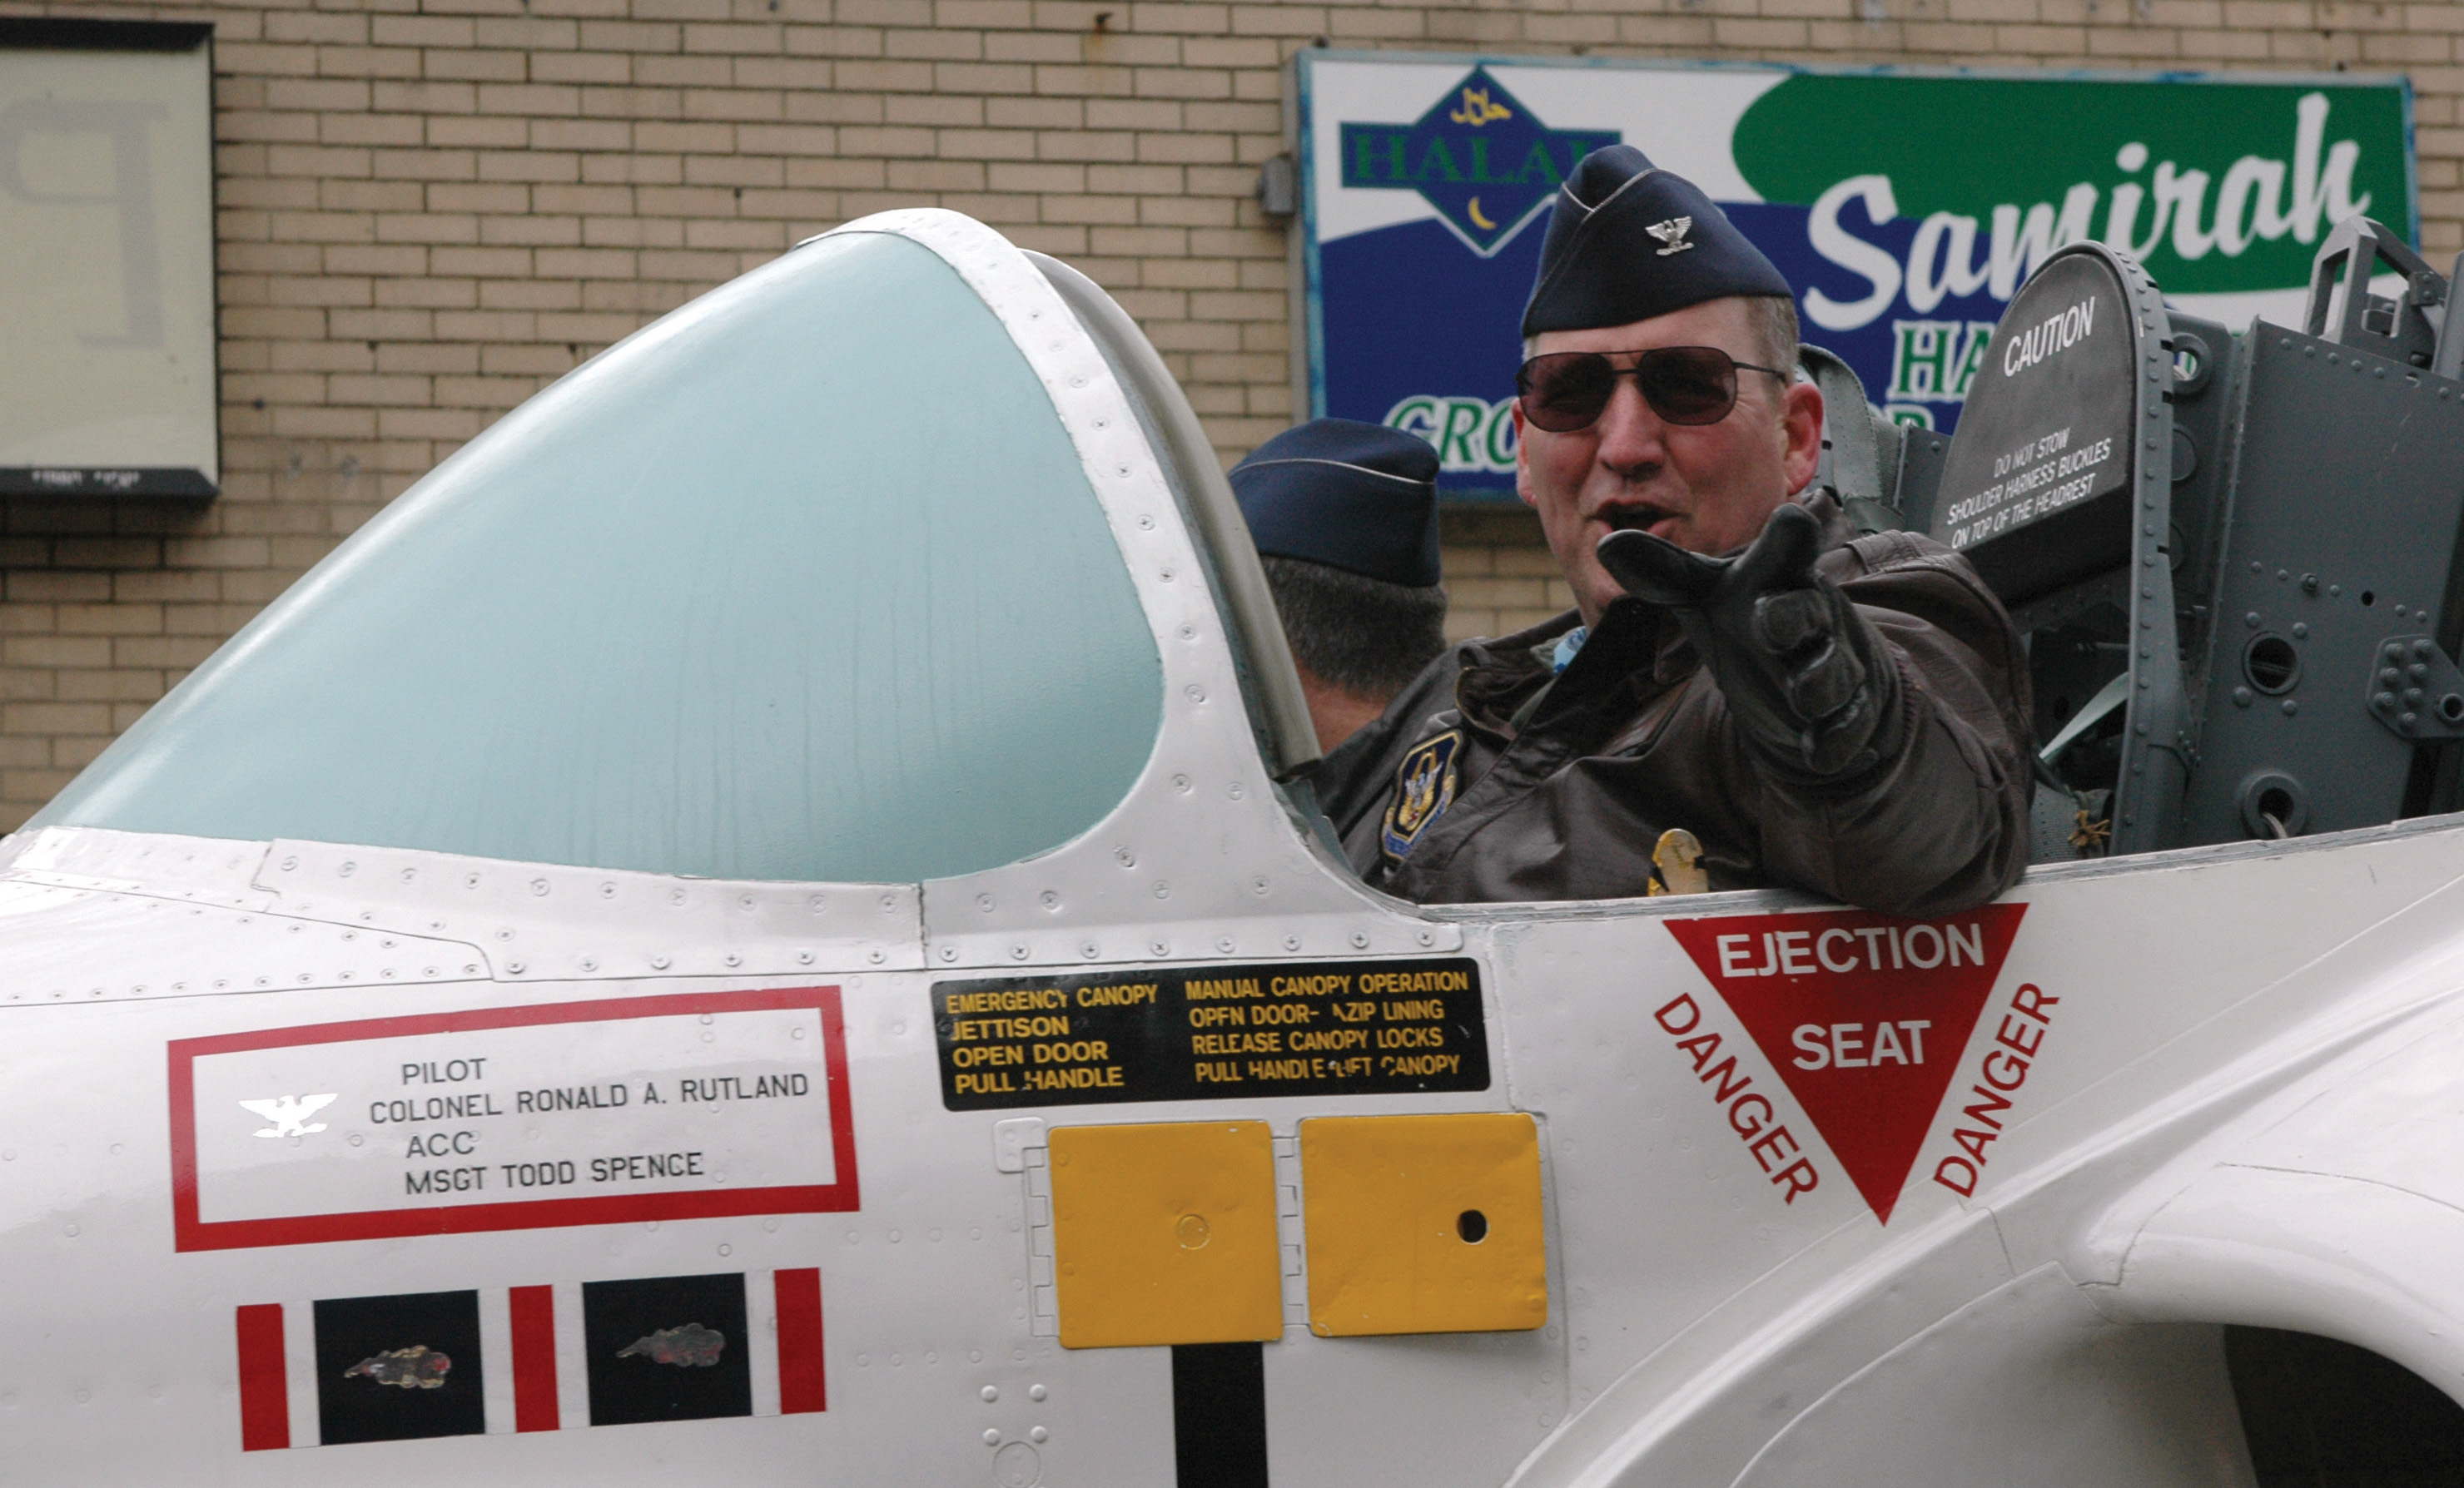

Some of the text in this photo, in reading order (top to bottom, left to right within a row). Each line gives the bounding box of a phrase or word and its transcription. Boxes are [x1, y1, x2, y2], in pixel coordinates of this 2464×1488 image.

[1803, 92, 2371, 331] Samirah
[2004, 295, 2095, 377] CAUTION
[1994, 427, 2070, 478] DO NOT STOW
[1947, 438, 2112, 525] SHOULDER HARNESS BUCKLES
[1951, 473, 2096, 549] ON TOP OF THE HEADREST
[1716, 923, 1985, 978] EJECTION
[946, 985, 1158, 1014] EMERGENCY CANOPY
[1185, 971, 1468, 1000] MANUAL CANOPY OPERATION
[951, 1016, 1070, 1040] JETTISON
[1383, 999, 1445, 1021] LINING
[952, 1041, 1109, 1068] OPEN DOOR
[1192, 1027, 1443, 1055] RELEASE CANOPY LOCKS
[1791, 1019, 1931, 1071] SEAT
[402, 1059, 487, 1085] PILOT
[955, 1066, 1125, 1094] PULL HANDLE
[1195, 1062, 1244, 1082] PULL
[1379, 1054, 1460, 1076] CANOPY
[370, 1074, 808, 1124] COLONEL RONALD A. RUTLAND
[1653, 991, 1820, 1206] DANGER
[1933, 983, 2060, 1198] DANGER
[405, 1130, 475, 1158] ACC
[405, 1152, 704, 1195] MSGT TODD SPENCE
